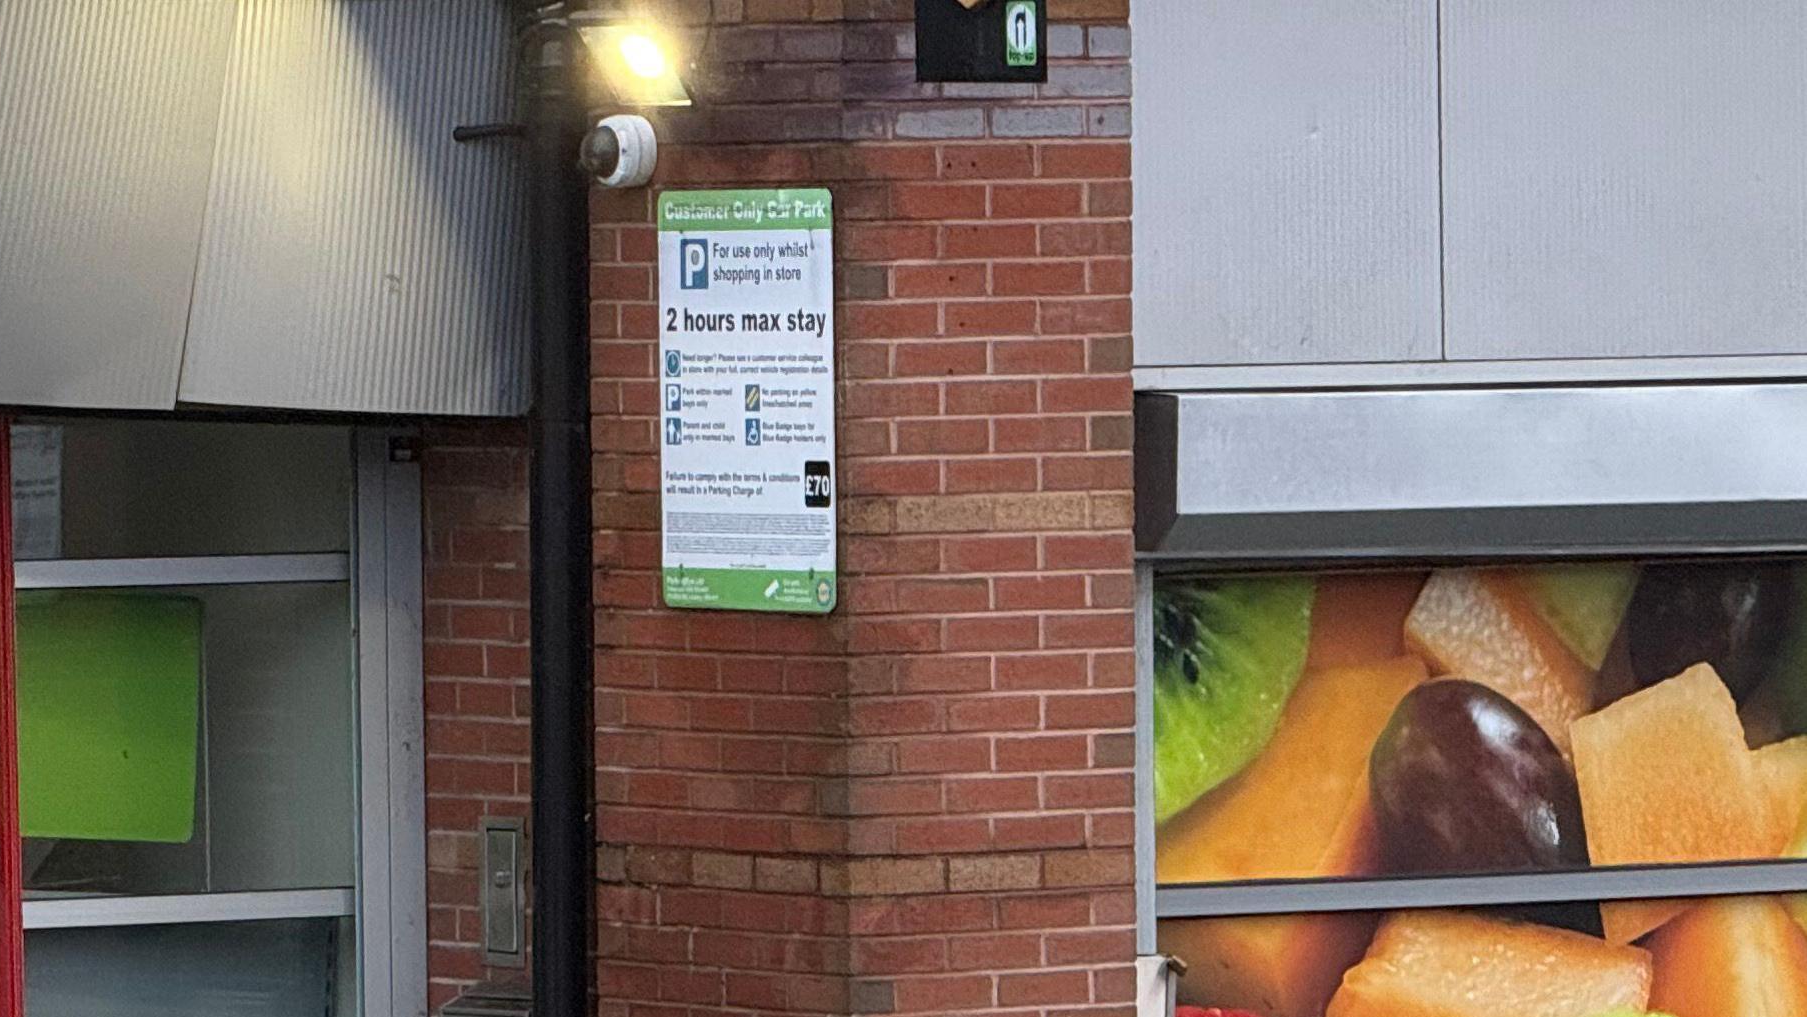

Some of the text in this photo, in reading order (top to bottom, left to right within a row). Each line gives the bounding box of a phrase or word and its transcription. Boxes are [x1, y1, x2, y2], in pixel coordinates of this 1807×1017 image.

[665, 201, 826, 223] Customer Only Car Park
[713, 242, 809, 262] For use only whilst
[713, 264, 802, 285] shopping in store
[666, 307, 826, 338] 2 hours max stay
[805, 474, 830, 497] £70
